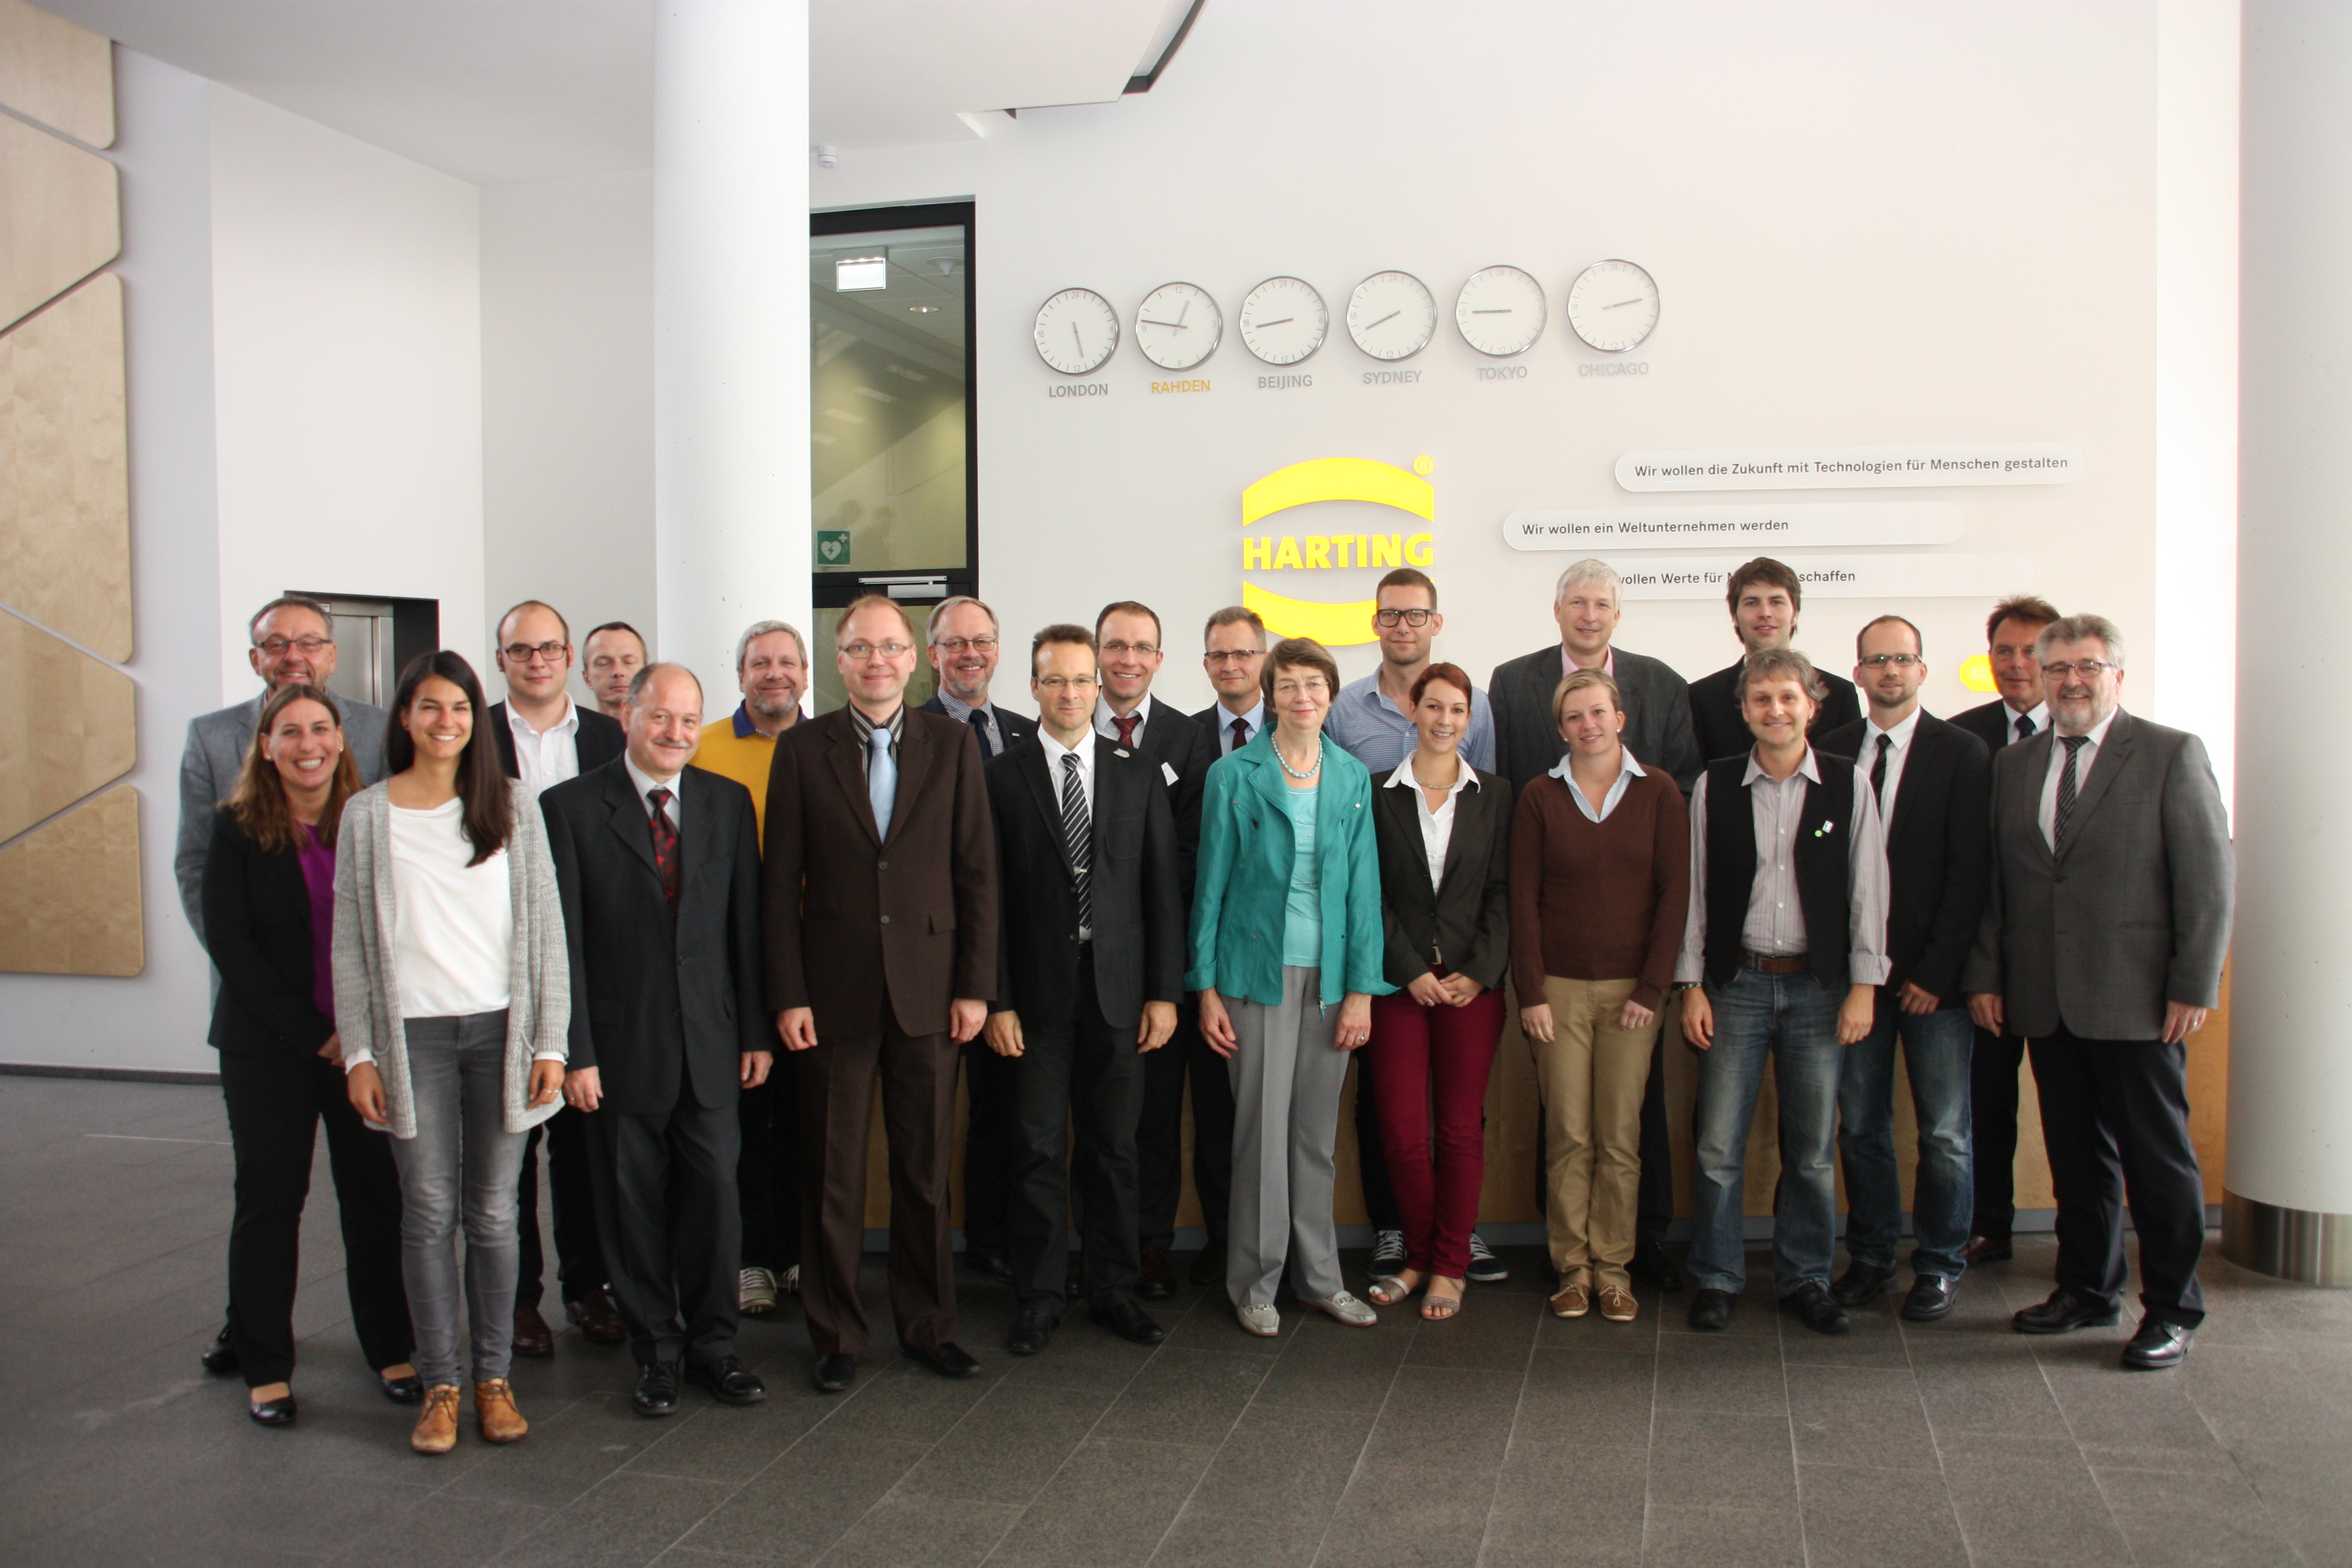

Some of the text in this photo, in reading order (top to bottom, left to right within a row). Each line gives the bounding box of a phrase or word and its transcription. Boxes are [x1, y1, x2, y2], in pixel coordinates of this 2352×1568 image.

[1476, 365, 1528, 380] TOKYO
[1578, 362, 1649, 377] CHICAGO
[1257, 374, 1313, 390] BEIJING
[1362, 370, 1422, 385] SYDNEY
[1048, 383, 1108, 398] LONDON
[1151, 379, 1211, 393] RAHDEN
[1635, 457, 2068, 477] Wir wollen die Zukunft mit Technologien für Menschen gestalten
[1522, 519, 1788, 535] Wir wollen ein Weltunternehmen werden
[1243, 533, 1433, 570] HARTING
[1660, 573, 1700, 584] Werte
[1703, 572, 1723, 583] für
[1798, 570, 1855, 582] schaffen
